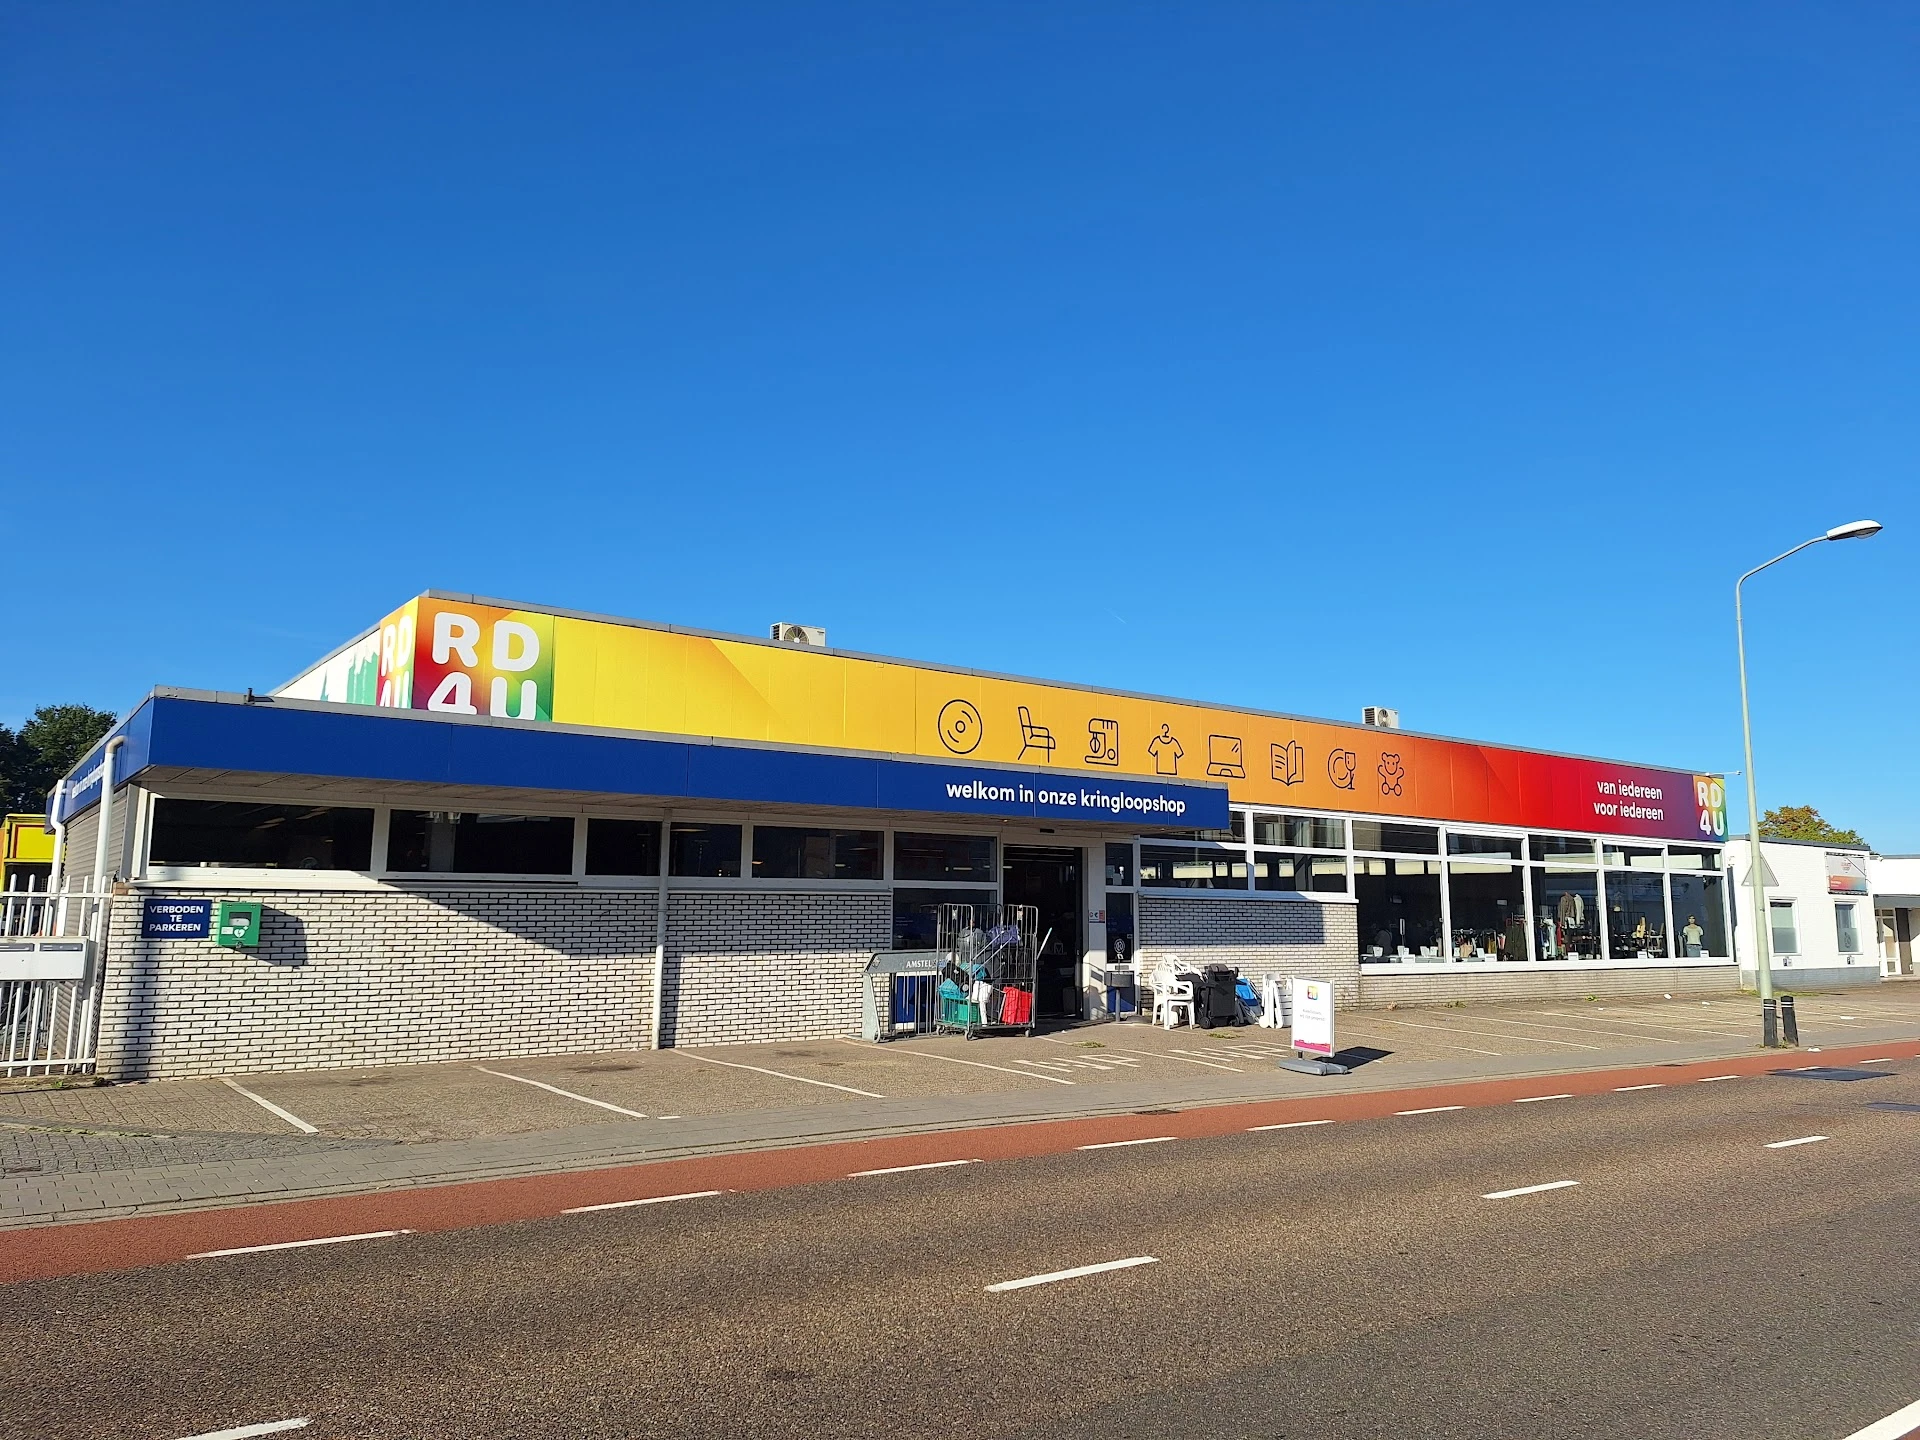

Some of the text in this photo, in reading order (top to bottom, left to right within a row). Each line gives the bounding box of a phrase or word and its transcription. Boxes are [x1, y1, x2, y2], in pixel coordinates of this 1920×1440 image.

[380, 615, 413, 677] RD
[432, 611, 540, 672] RD
[427, 671, 538, 721] 4U
[946, 781, 1186, 816] welkom in onze kringloopshop
[1597, 779, 1663, 800] van iedereen
[1697, 781, 1722, 808] RD
[1593, 801, 1664, 821] voor iedereen
[1699, 809, 1725, 837] 4U
[150, 905, 204, 914] VERBODEN
[170, 914, 182, 923] TE
[149, 923, 201, 932] PARKEREN
